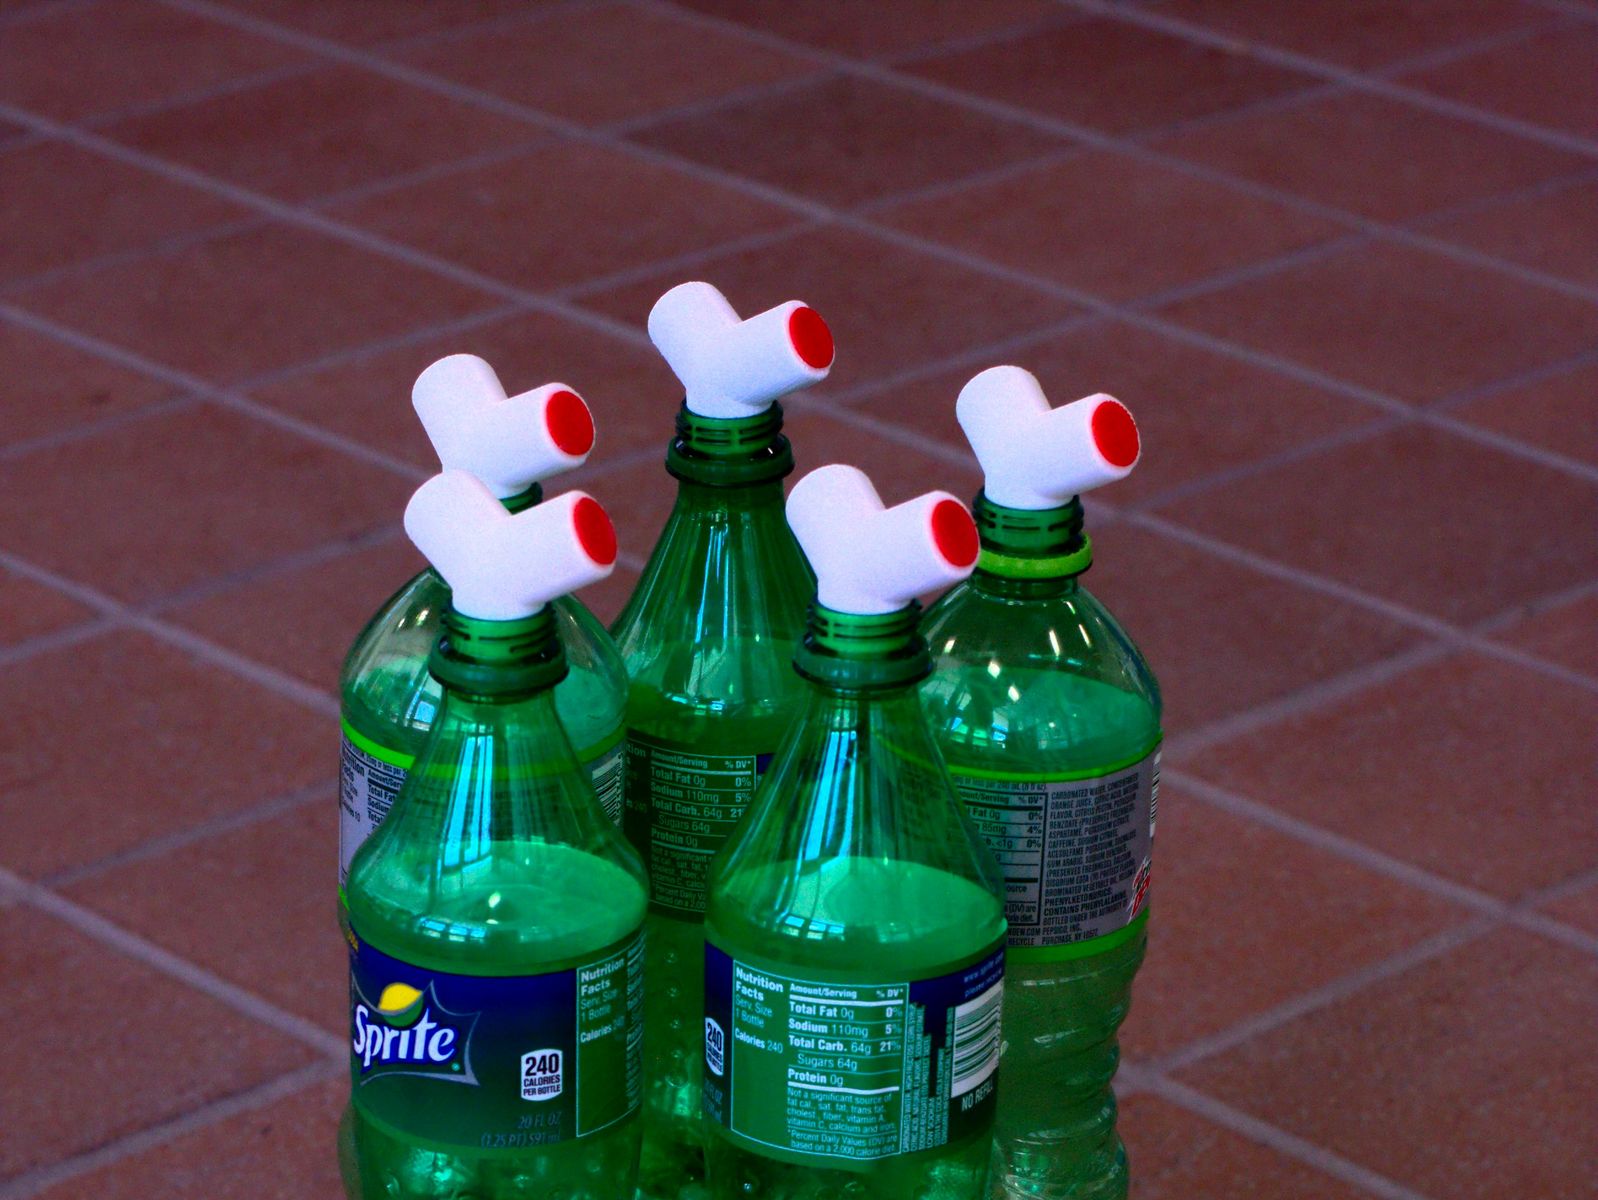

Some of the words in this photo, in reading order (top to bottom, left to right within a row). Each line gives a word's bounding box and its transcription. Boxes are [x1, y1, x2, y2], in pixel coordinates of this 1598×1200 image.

[651, 767, 673, 781] Total
[675, 771, 690, 783] Fat
[693, 776, 706, 787] 0g
[735, 777, 752, 787] 0%
[651, 781, 683, 798] Sodium
[686, 790, 719, 804] 110mg
[735, 793, 752, 802] 5%
[651, 797, 673, 811] Total
[703, 808, 722, 819] 64g
[1028, 811, 1043, 820] 0%
[692, 821, 710, 832] 64g
[1027, 825, 1042, 834] 4%
[1026, 839, 1042, 848] 0%
[1044, 903, 1080, 917] CONTAINS
[581, 958, 625, 983] Nutrition
[736, 967, 784, 993] Nutrition
[581, 979, 611, 997] Facts
[736, 983, 765, 1002] Facts
[790, 983, 858, 999] Amount/Serving
[736, 995, 754, 1009] Serv.
[755, 1003, 773, 1018] Size
[789, 1002, 816, 1018] Total
[819, 1004, 838, 1018] Fat
[841, 1008, 855, 1021] 0g
[886, 1007, 902, 1019] 0%
[581, 1011, 586, 1022] 1
[736, 1008, 740, 1019] 1
[741, 1011, 765, 1029] Bottle
[353, 1004, 455, 1067] Sprite
[580, 1024, 612, 1044] Calories
[707, 1023, 723, 1052] 240
[789, 1019, 828, 1034] Sodium
[832, 1023, 869, 1038] 110mg
[885, 1022, 902, 1035] 5%
[735, 1027, 766, 1050] Calories
[767, 1041, 784, 1055] 240
[789, 1035, 815, 1050] Total
[818, 1039, 847, 1052] Carb.
[851, 1041, 872, 1056] 64g
[880, 1040, 902, 1052] 21%
[525, 1053, 560, 1076] 240
[797, 1054, 834, 1072] Sugars
[837, 1058, 858, 1072] 64g
[523, 1075, 561, 1088] CALORIES
[788, 1069, 827, 1084] Protein
[830, 1073, 844, 1086] 0g
[523, 1088, 537, 1096] PER
[538, 1084, 561, 1095] BOTTLE
[811, 1091, 853, 1103] significant
[961, 1093, 975, 1113] NO
